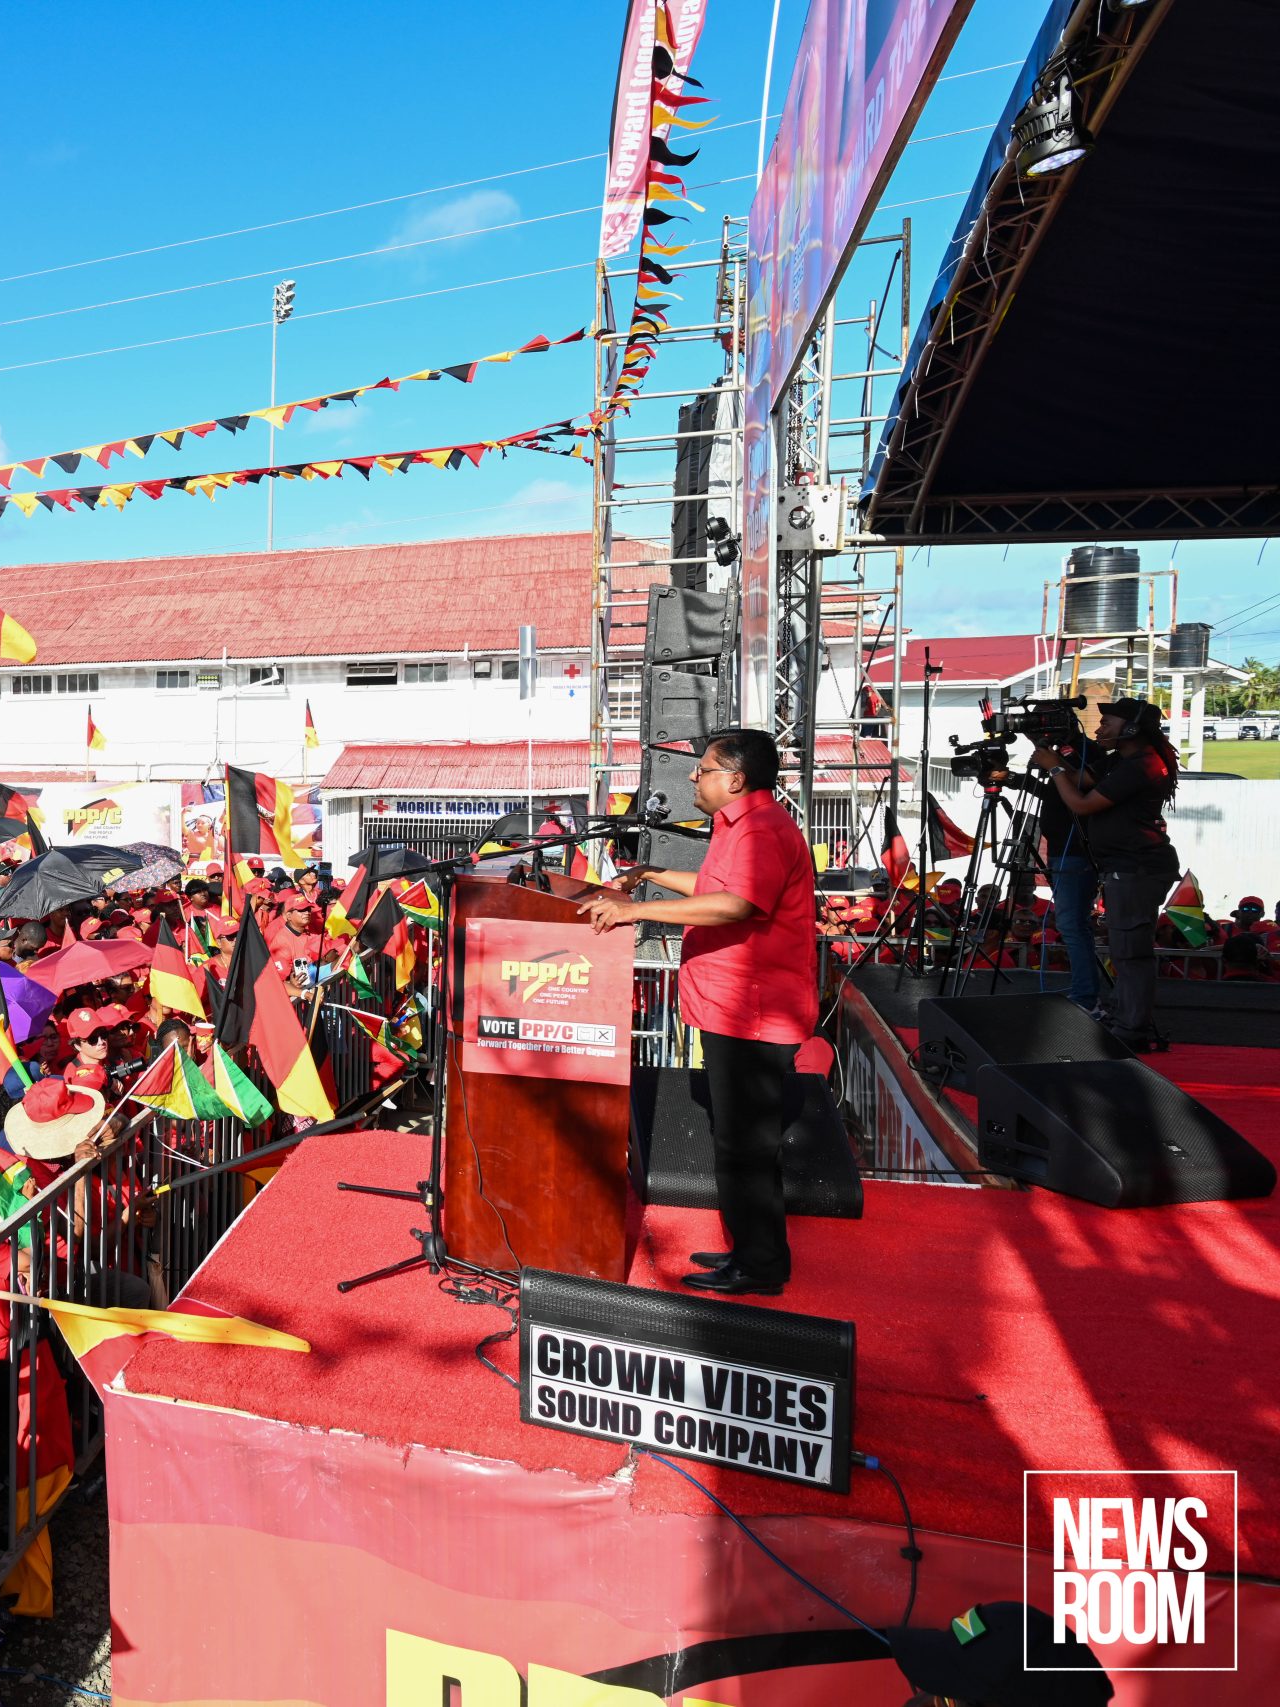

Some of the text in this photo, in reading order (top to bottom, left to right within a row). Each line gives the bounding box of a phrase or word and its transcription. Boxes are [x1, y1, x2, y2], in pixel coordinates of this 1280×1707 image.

[610, 91, 647, 189] Forward
[63, 807, 122, 826] PPP/C
[396, 801, 443, 815] MOBILE
[445, 801, 500, 816] MEDICAL
[501, 956, 592, 986] PPP/C
[546, 998, 569, 1006] FUTURE
[553, 992, 576, 1000] PEOPLE
[482, 1019, 574, 1040] VOTE PPP/C
[477, 1038, 507, 1048] Forward
[508, 1040, 542, 1052] Together
[543, 1043, 554, 1052] for
[561, 1044, 585, 1056] Better
[586, 1046, 616, 1058] Guyana
[537, 1333, 827, 1432] CROWN VIBES
[537, 1385, 824, 1478] SOUND COMPANY
